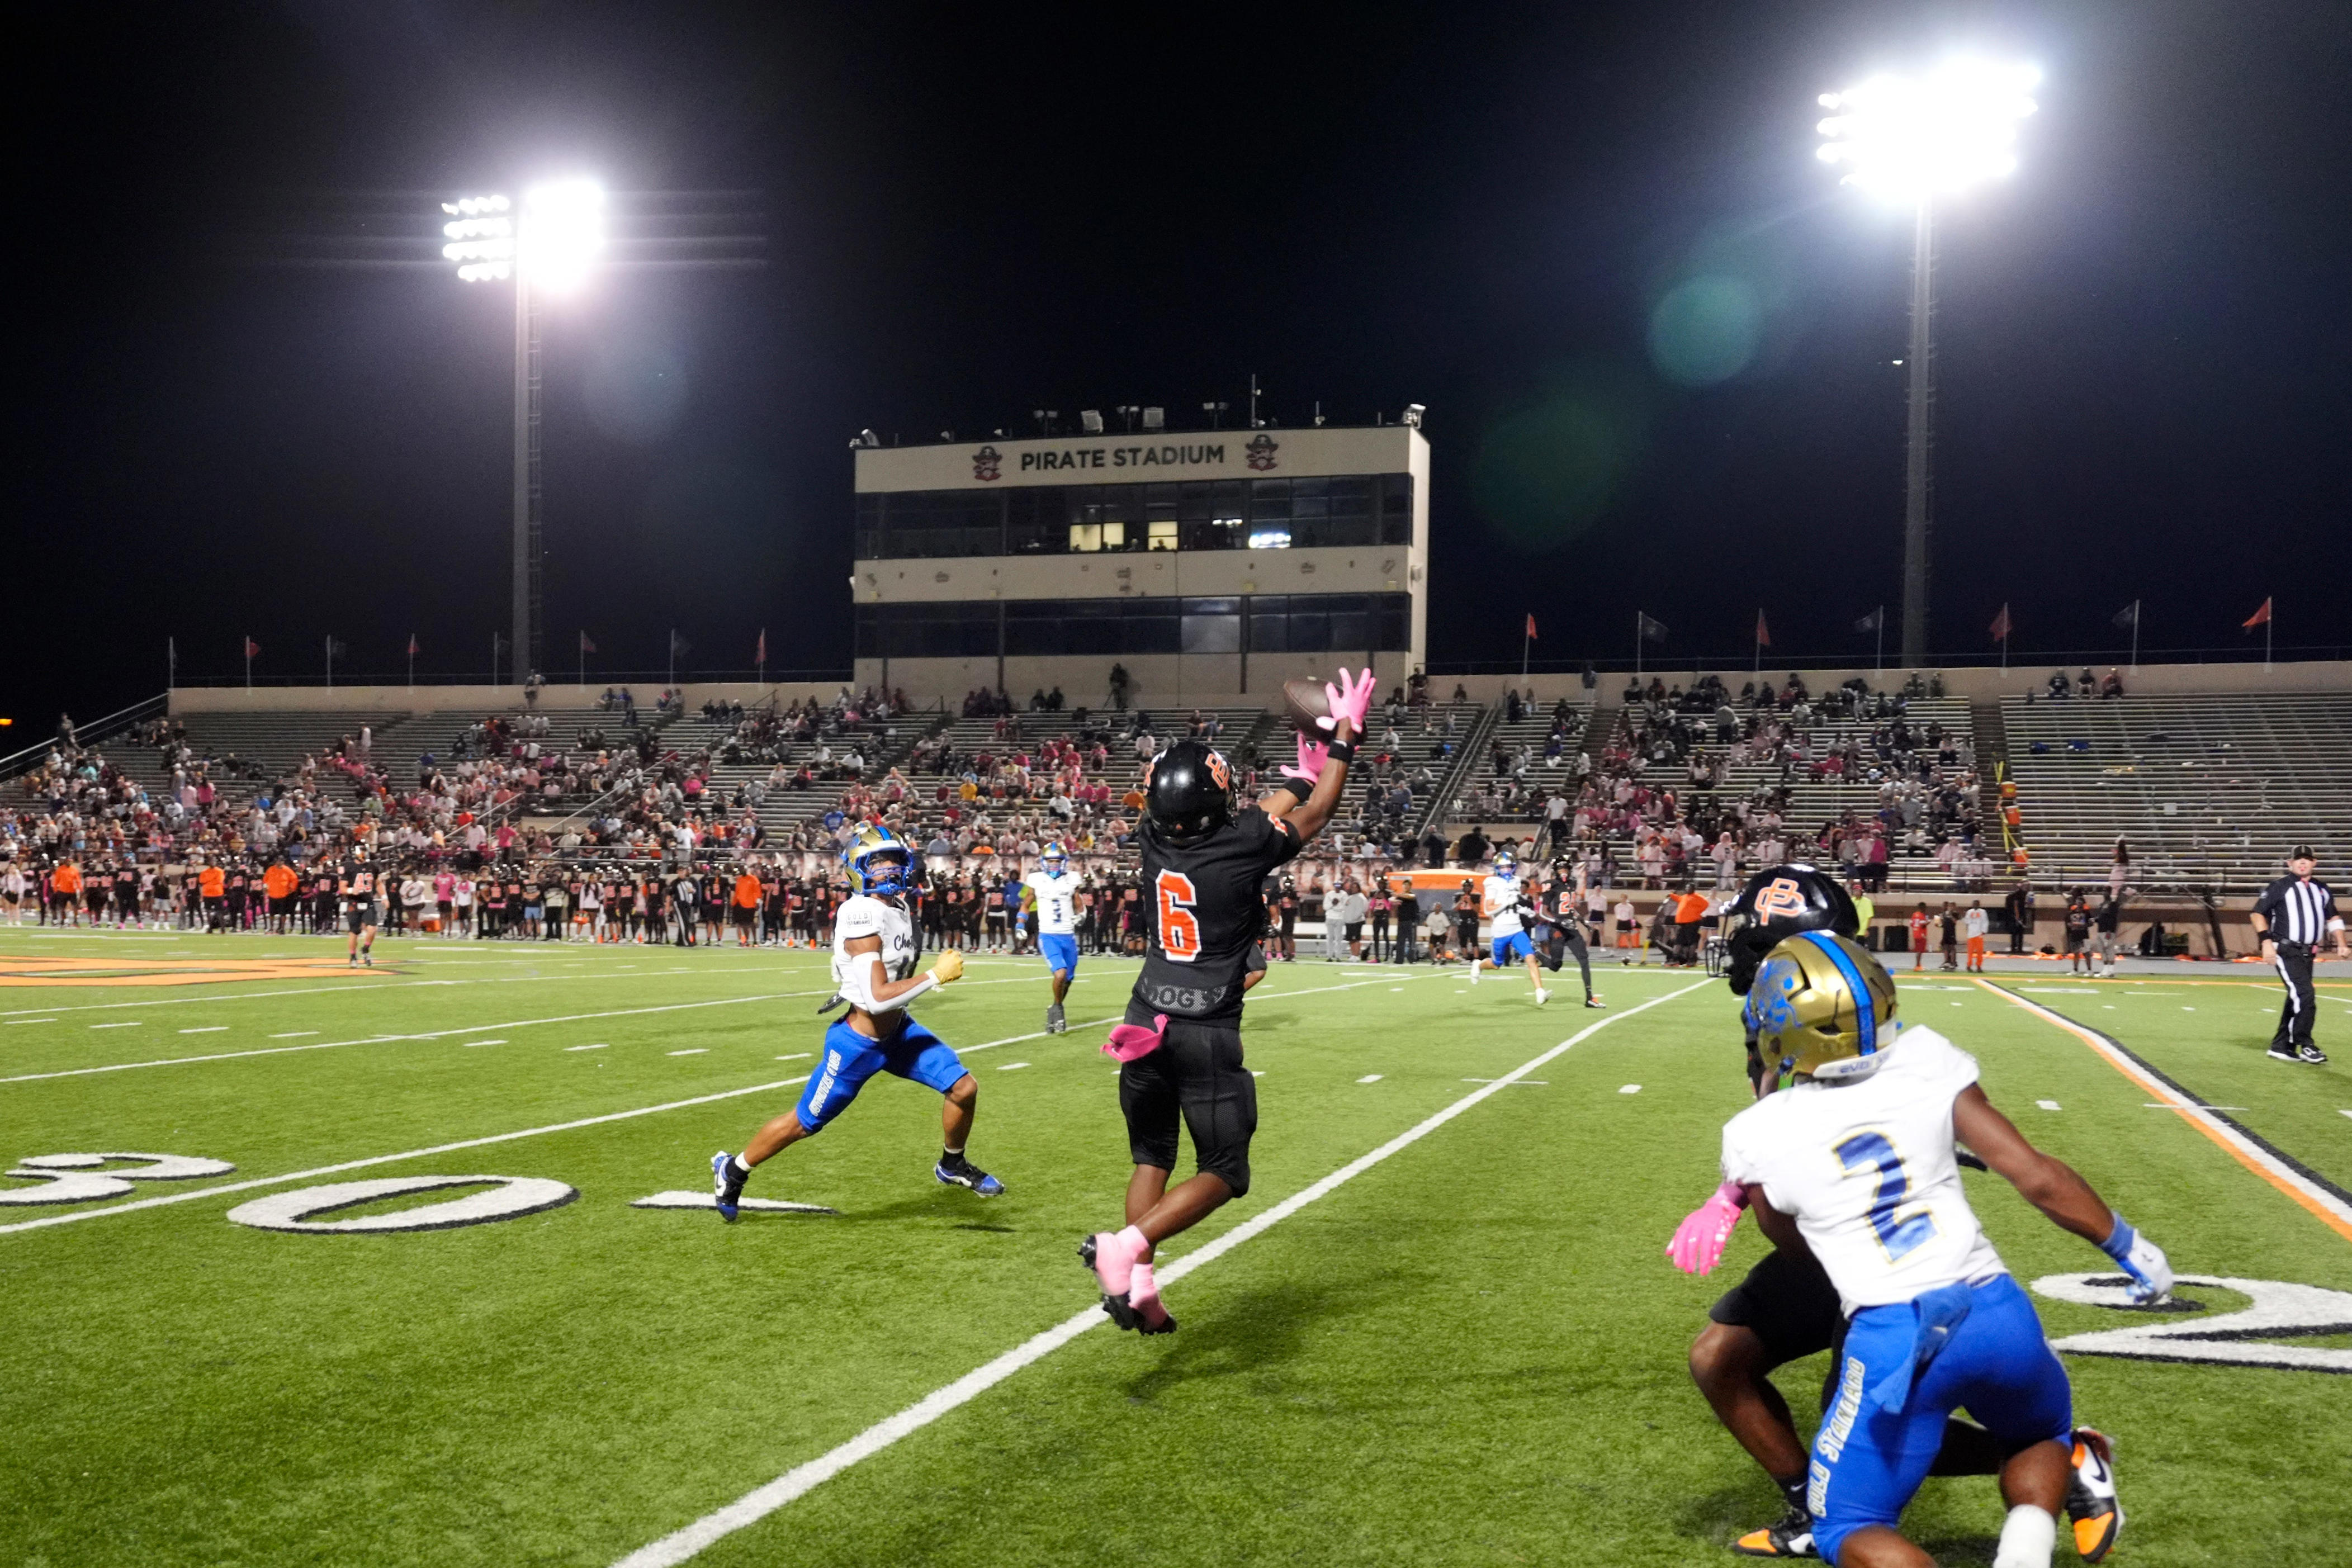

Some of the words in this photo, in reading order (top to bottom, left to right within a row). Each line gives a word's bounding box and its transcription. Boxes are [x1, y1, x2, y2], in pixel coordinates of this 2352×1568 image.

[1021, 449, 1105, 471] PIRATE
[1113, 445, 1225, 467] STADIUM
[894, 932, 913, 951] Cho
[1155, 868, 1201, 962] 6
[1831, 1128, 1947, 1266] 2
[1817, 1356, 1866, 1463] STANDARD
[1807, 1459, 1831, 1518] GOLD
